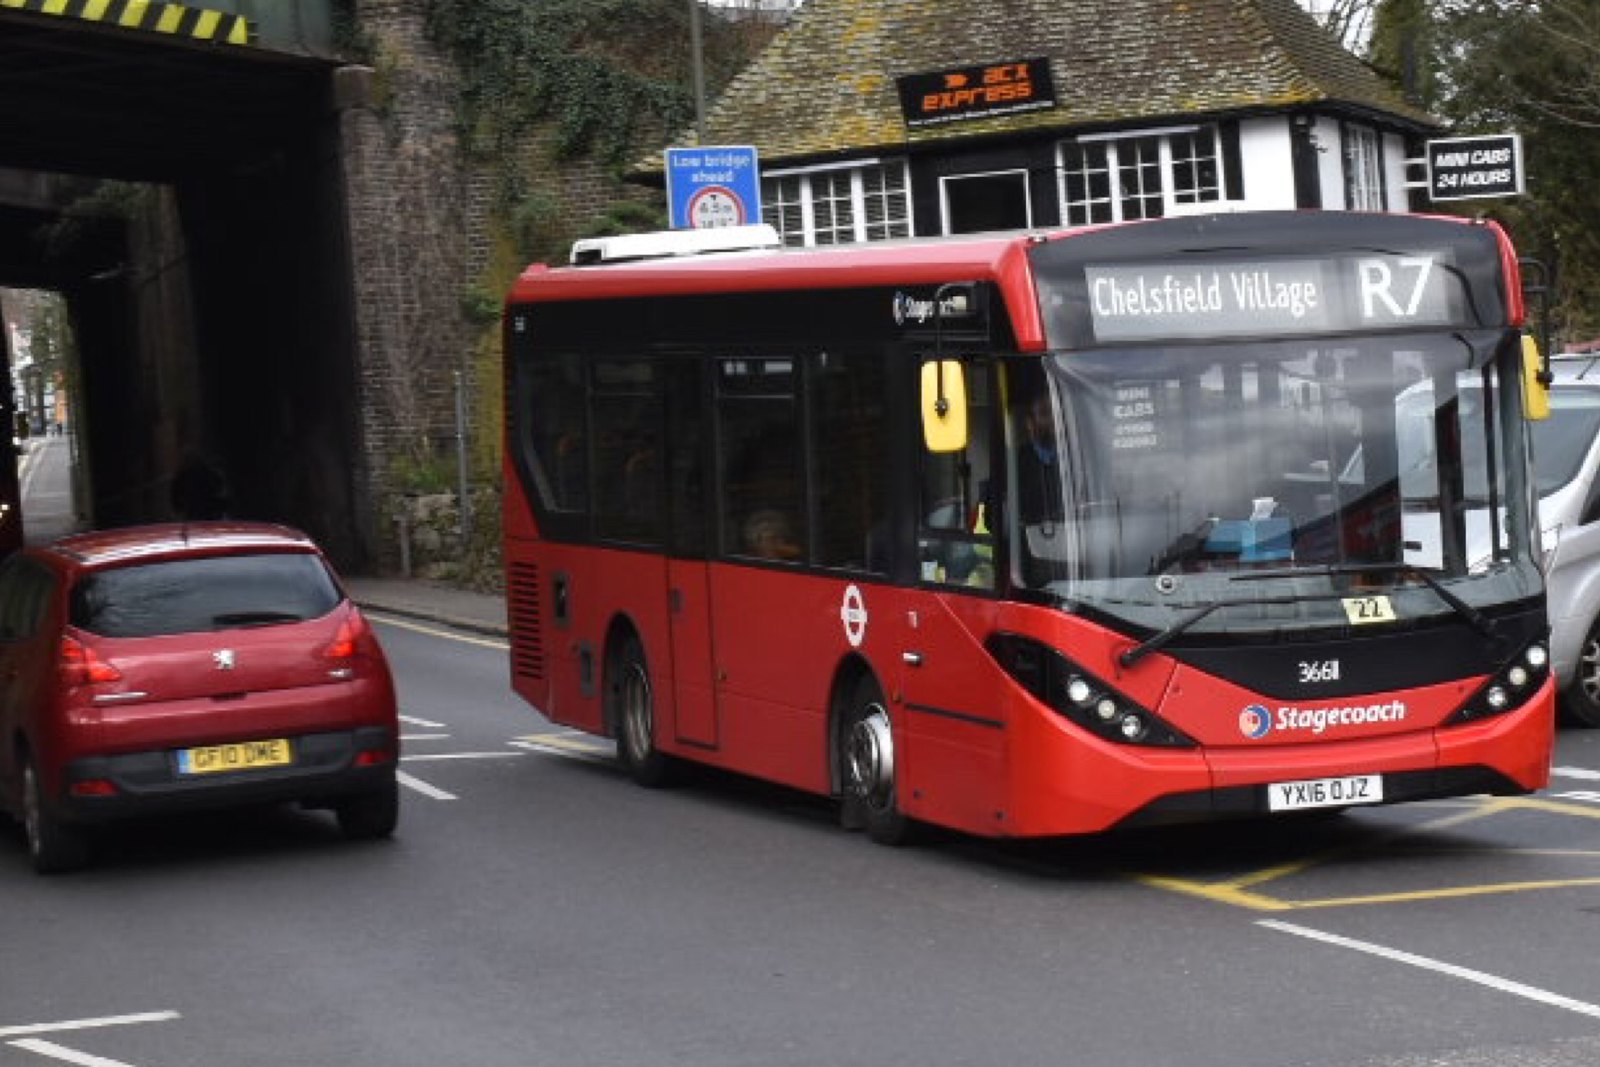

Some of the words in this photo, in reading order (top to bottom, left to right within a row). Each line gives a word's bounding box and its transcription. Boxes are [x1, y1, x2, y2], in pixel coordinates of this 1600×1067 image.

[673, 155, 700, 167] Low
[704, 153, 750, 169] bridge
[691, 170, 734, 182] ahead
[1437, 173, 1459, 188] 24
[1460, 168, 1512, 187] HOURS
[1094, 274, 1222, 316] Chelsfield
[1231, 271, 1317, 317] Village
[1357, 256, 1433, 318] R7
[1352, 598, 1383, 618] 22
[1275, 700, 1406, 734] Stagecoach
[1281, 783, 1326, 805] YX16
